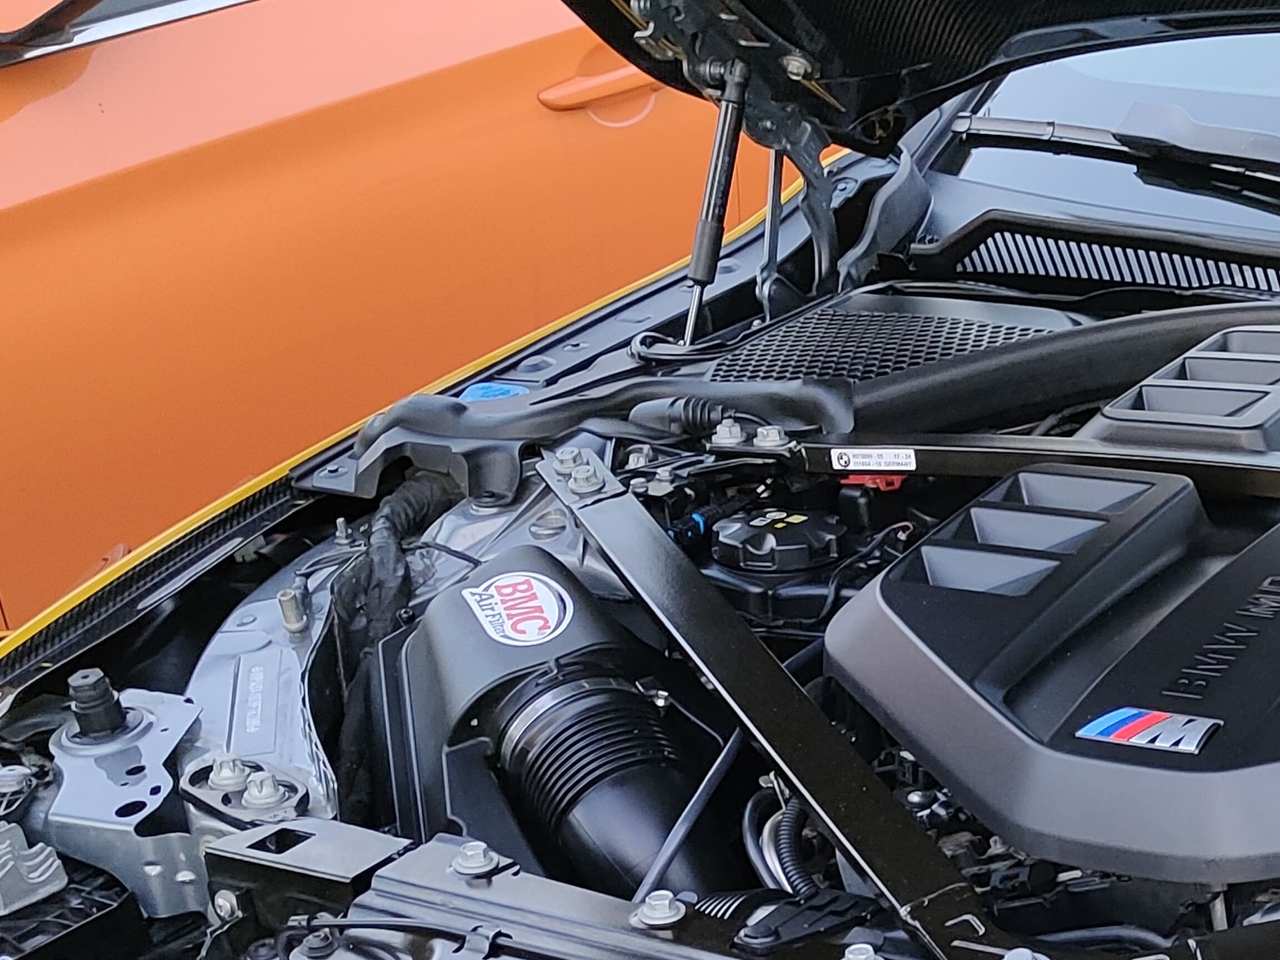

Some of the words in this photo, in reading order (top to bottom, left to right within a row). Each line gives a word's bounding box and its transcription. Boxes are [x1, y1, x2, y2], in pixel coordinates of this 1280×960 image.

[468, 591, 499, 612] Air
[494, 578, 551, 635] BMC
[1160, 621, 1259, 700] BMW
